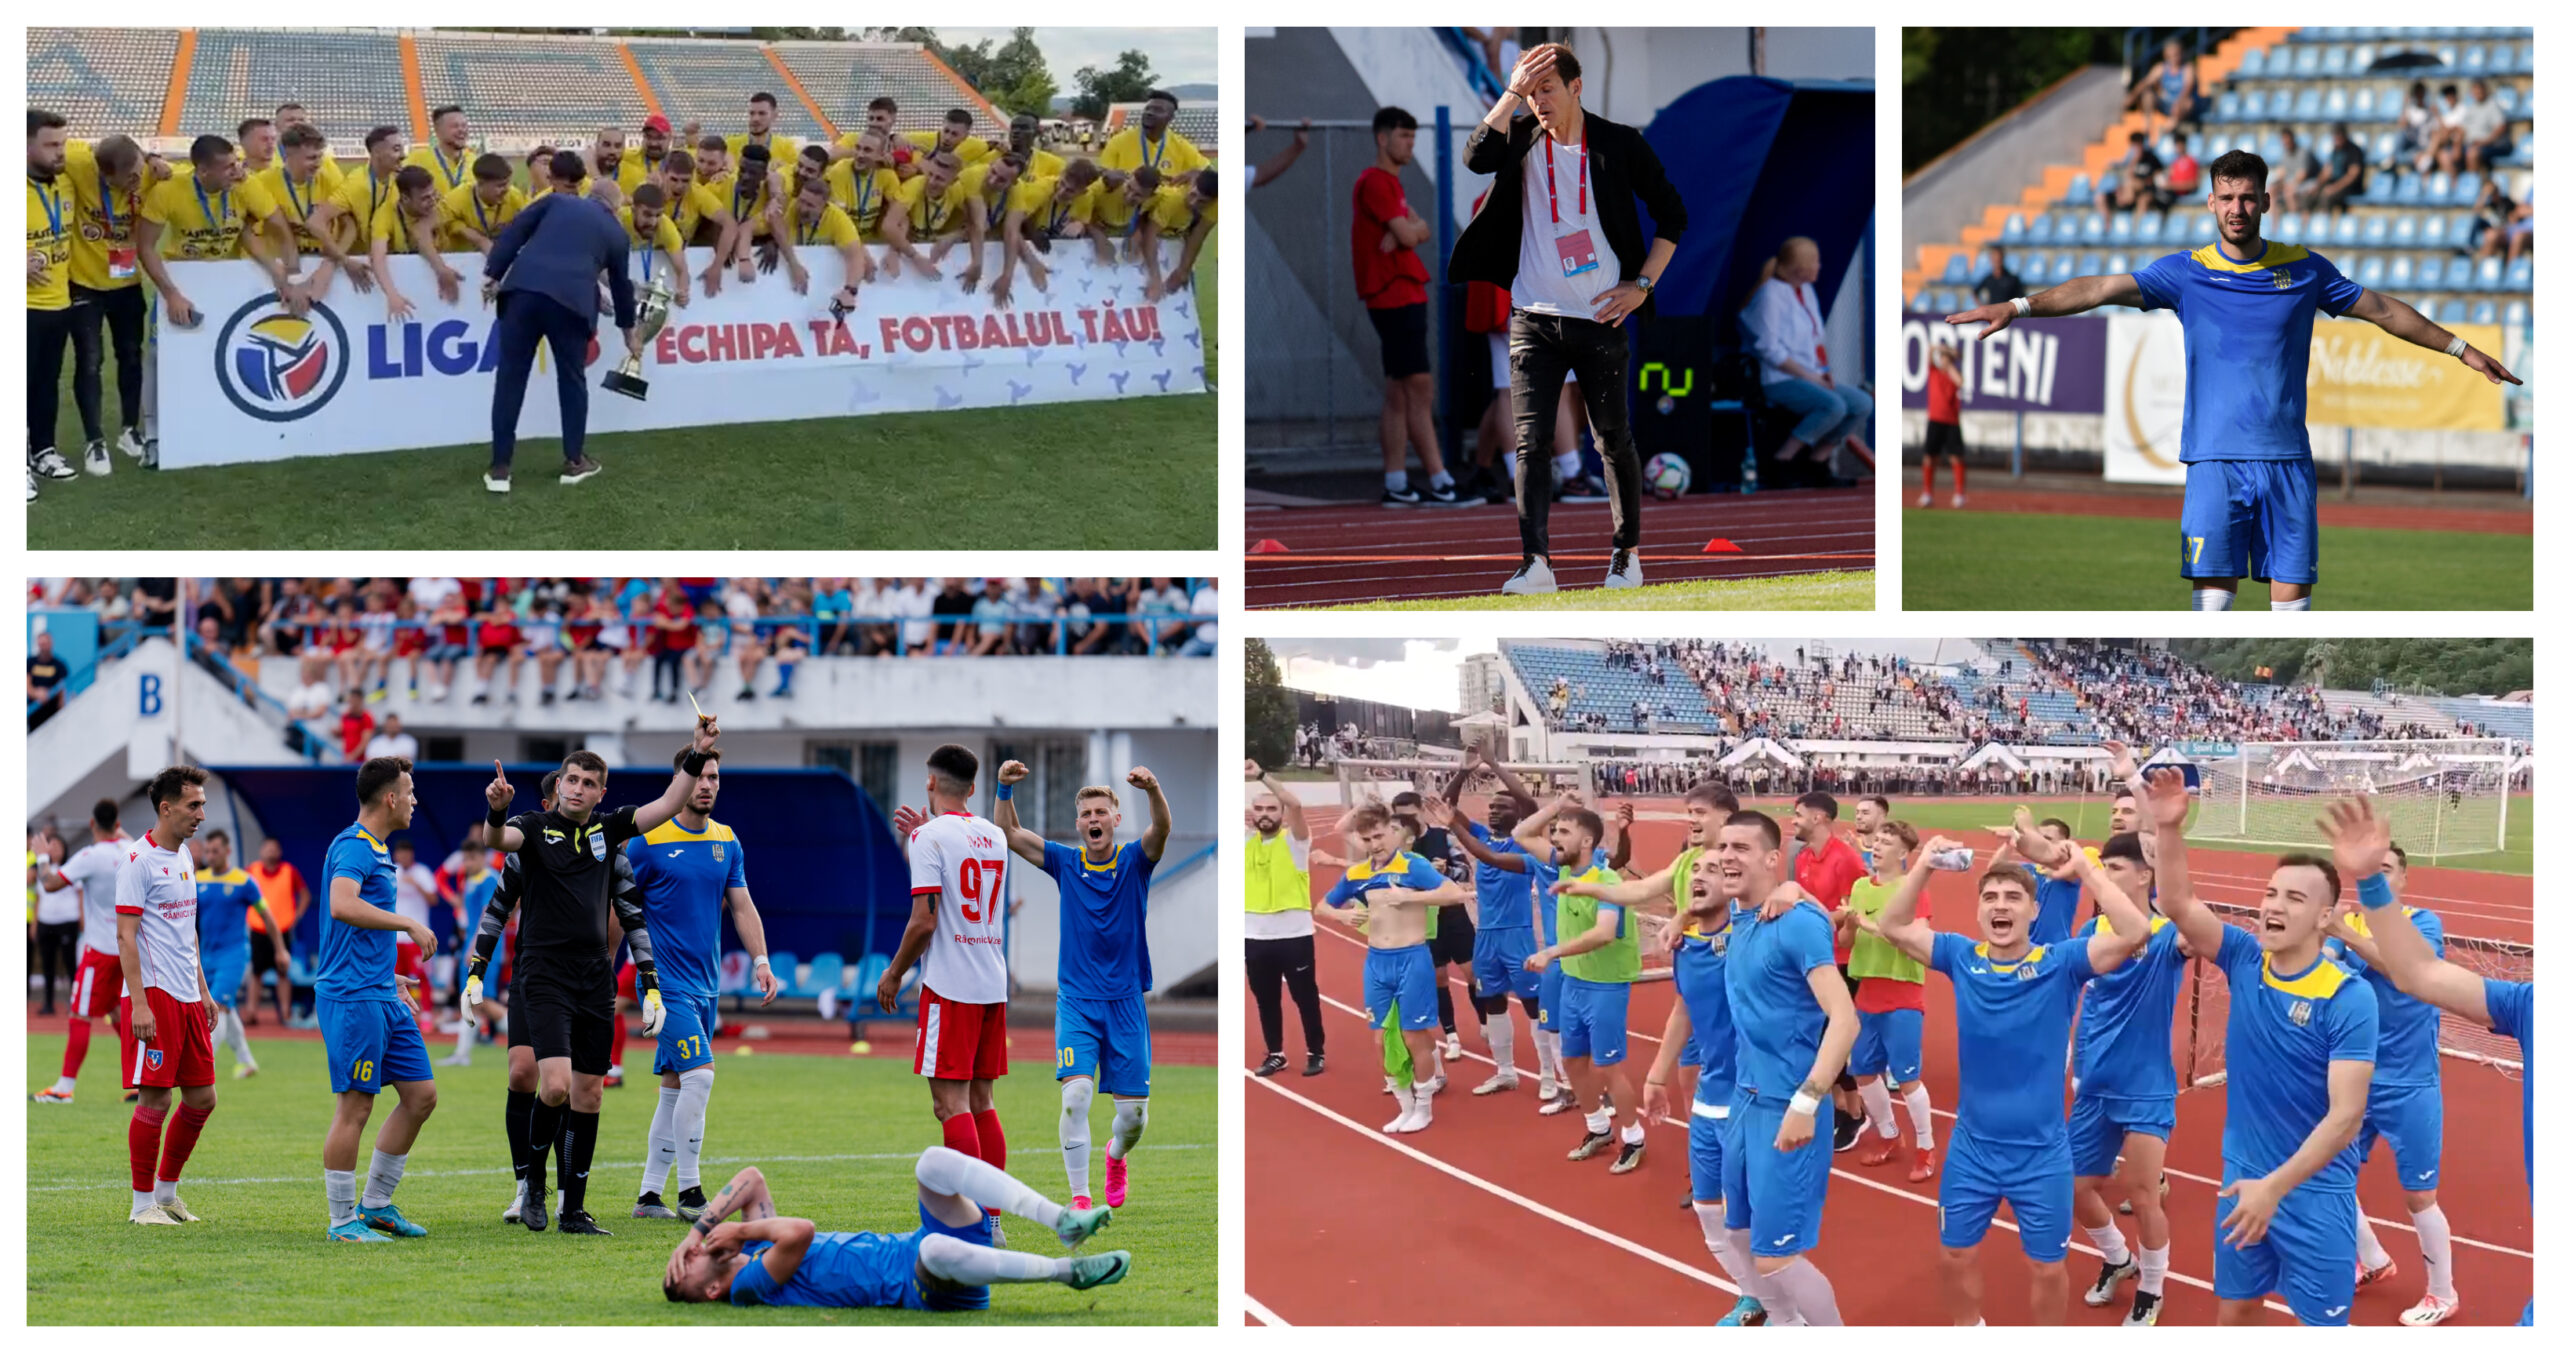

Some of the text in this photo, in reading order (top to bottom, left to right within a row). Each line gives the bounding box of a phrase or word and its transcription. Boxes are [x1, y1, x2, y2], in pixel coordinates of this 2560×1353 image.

[656, 322, 804, 364] ECHIPA
[878, 311, 1074, 353] FOTBALUL
[1077, 299, 1162, 343] TĂU!
[2184, 536, 2205, 565] 37
[140, 673, 162, 716] B
[590, 834, 603, 844] FIFA
[960, 857, 1005, 926] 97
[677, 1035, 700, 1060] 37
[1057, 1046, 1075, 1069] 30
[353, 1059, 374, 1082] 16
